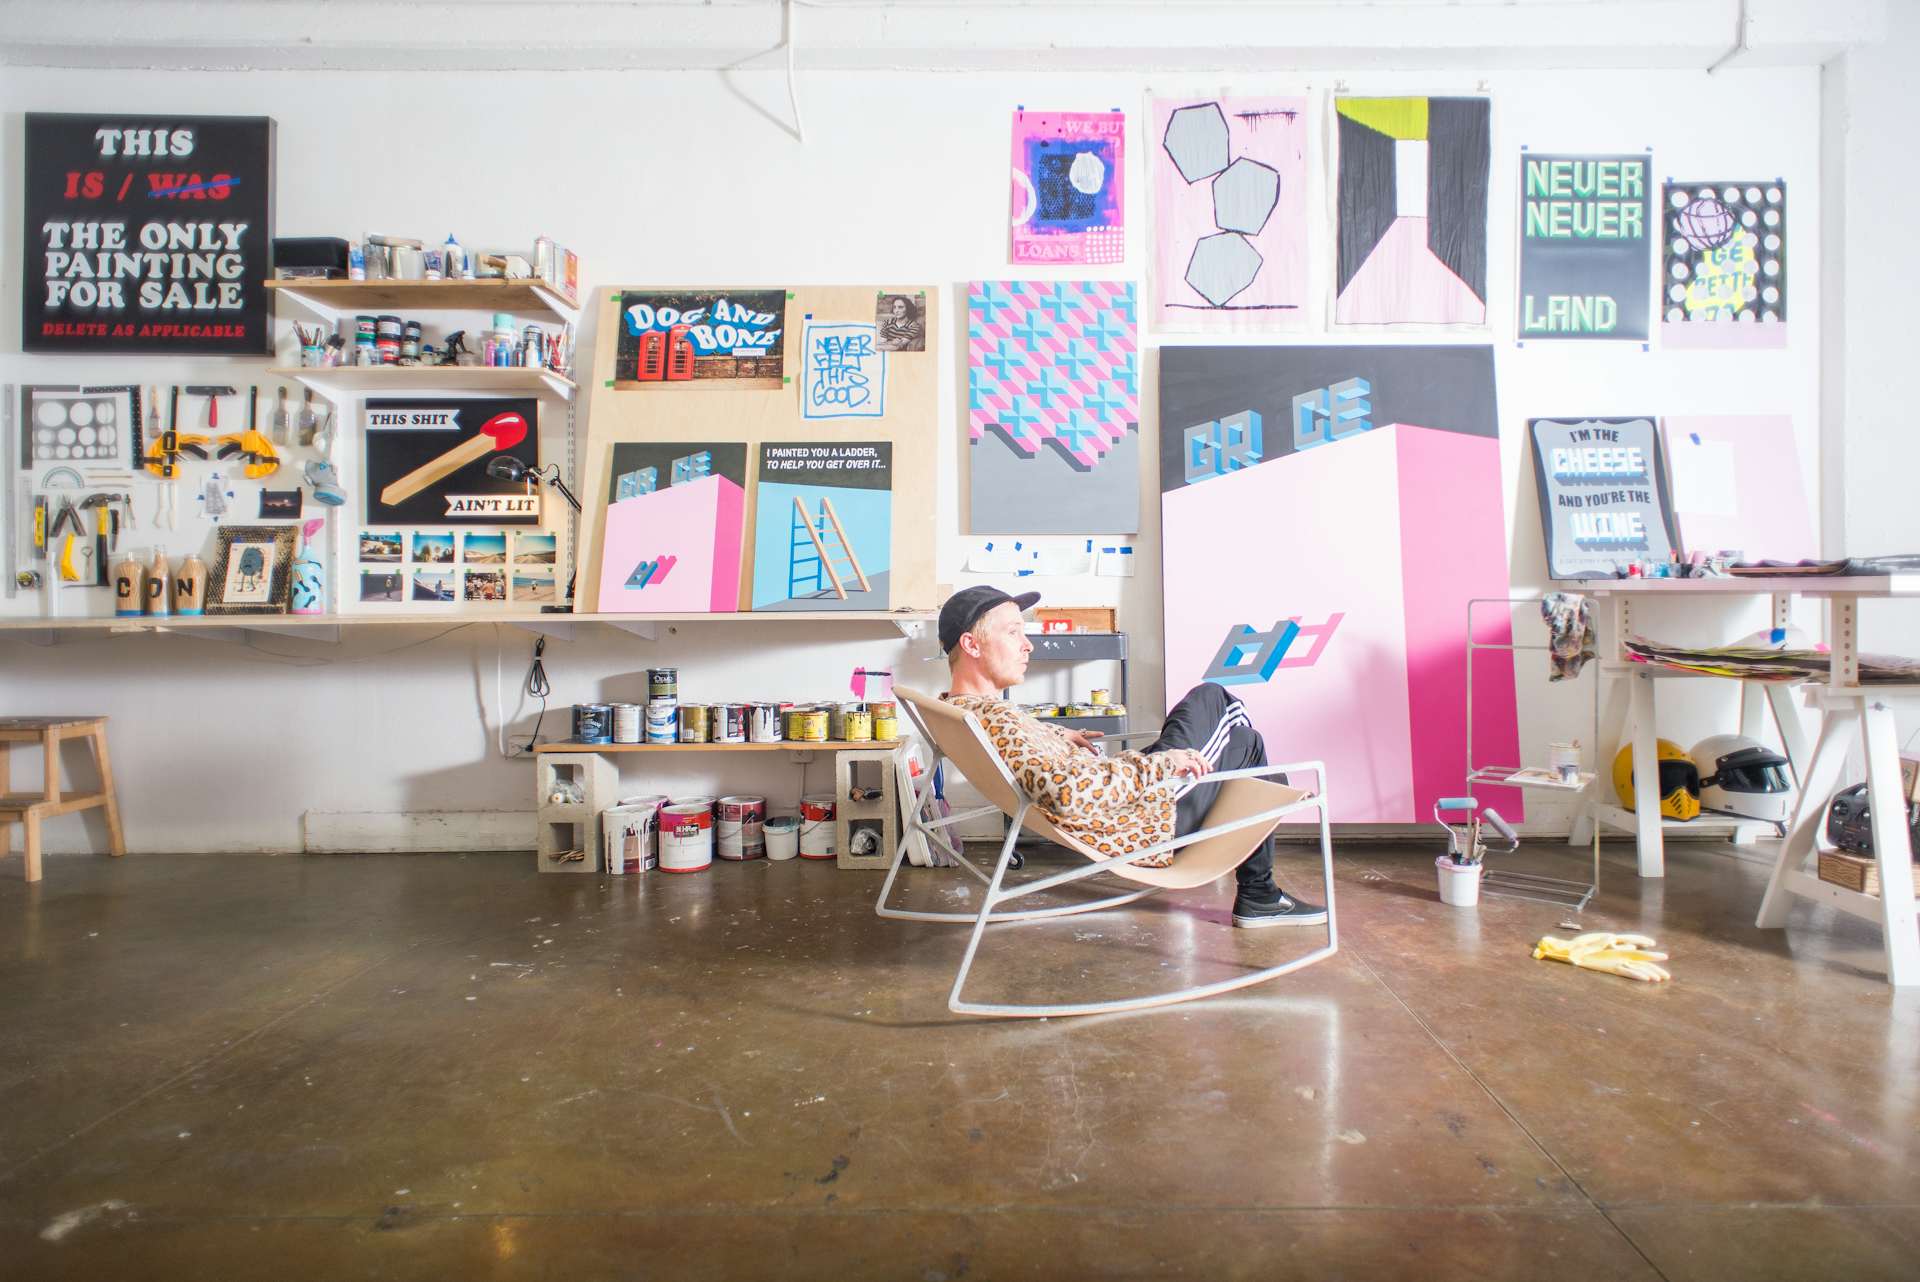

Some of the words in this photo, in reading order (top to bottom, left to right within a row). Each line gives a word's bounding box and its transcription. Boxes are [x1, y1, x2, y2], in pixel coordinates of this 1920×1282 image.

[95, 129, 194, 156] THIS
[64, 172, 105, 199] IS
[147, 173, 235, 201] WAS
[1526, 160, 1644, 199] NEVER
[1525, 201, 1644, 240] NEVER
[43, 222, 126, 250] THE
[139, 222, 248, 250] ONLY
[45, 252, 245, 279] PAINTING
[45, 281, 125, 308] FOR
[139, 282, 243, 310] SALE
[627, 304, 705, 330] DOG
[714, 299, 776, 325] AND
[1524, 295, 1617, 333] LAND
[42, 323, 107, 337] DELETE
[112, 324, 136, 338] AS
[139, 325, 245, 338] APPLICABLE
[690, 324, 782, 350] BONE
[816, 334, 876, 355] NEVER
[813, 366, 869, 389] THIS
[370, 414, 407, 425] THIS
[411, 414, 449, 425] SHIT
[1569, 429, 1591, 443] I'M
[1593, 428, 1620, 442] THE
[766, 460, 779, 469] TO
[780, 460, 804, 469] HELP
[806, 460, 825, 469] YOU
[826, 460, 844, 469] GET
[846, 459, 870, 469] OVER
[772, 448, 809, 457] PAINTED
[811, 448, 829, 457] YOU
[831, 448, 838, 457] A
[840, 447, 877, 458] LADDER,
[453, 499, 502, 512] AIN'T
[505, 500, 536, 511] LIT
[1558, 494, 1583, 508] AND
[1585, 490, 1626, 507] YOU'RE
[1628, 490, 1651, 504] THE
